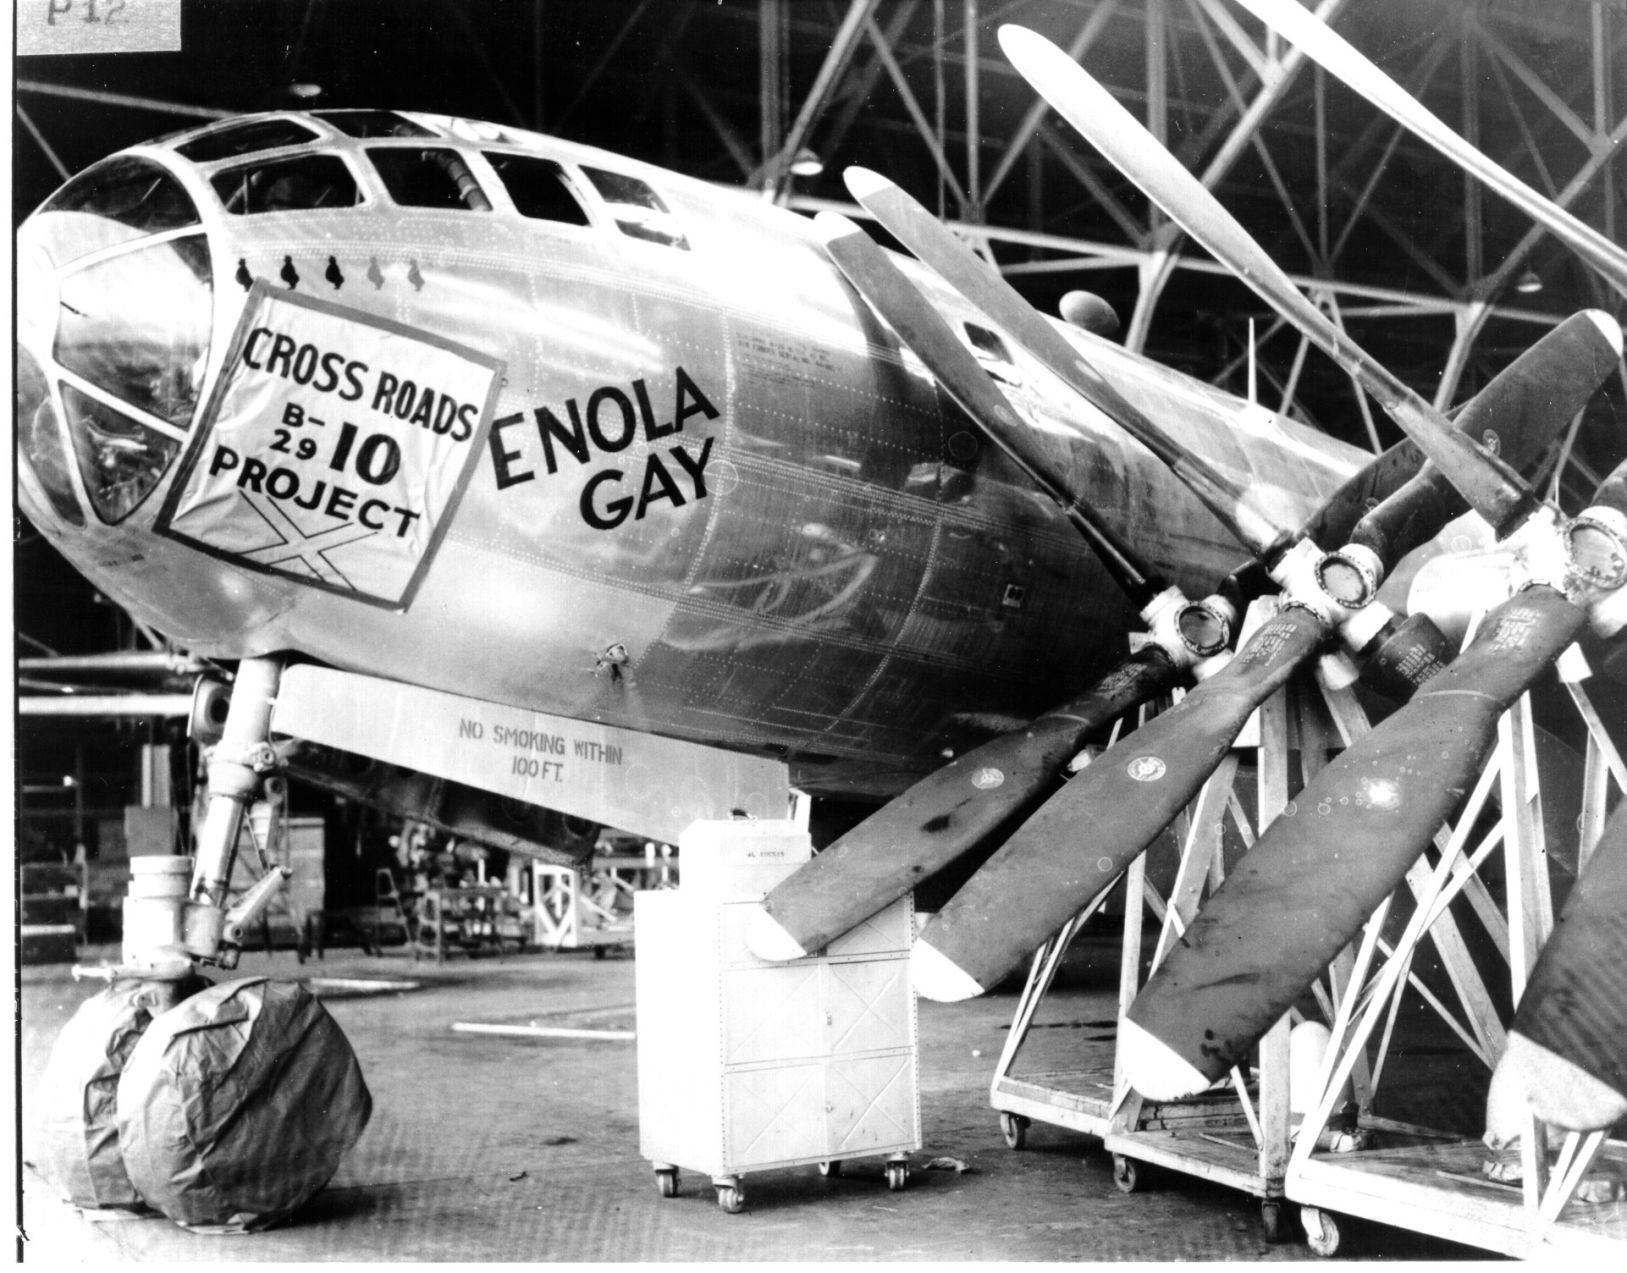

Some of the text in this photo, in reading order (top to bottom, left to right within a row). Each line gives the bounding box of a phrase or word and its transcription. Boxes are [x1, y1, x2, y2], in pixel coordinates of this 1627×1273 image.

[241, 327, 478, 442] CROSS ROADS
[269, 428, 317, 461] 29
[329, 421, 401, 486] 10
[489, 366, 720, 490] ENOLA
[208, 444, 421, 539] PROJECT
[580, 436, 715, 530] GAY
[459, 718, 623, 766] NO SMOKING WITHIN
[511, 755, 565, 783] 100 FT.
